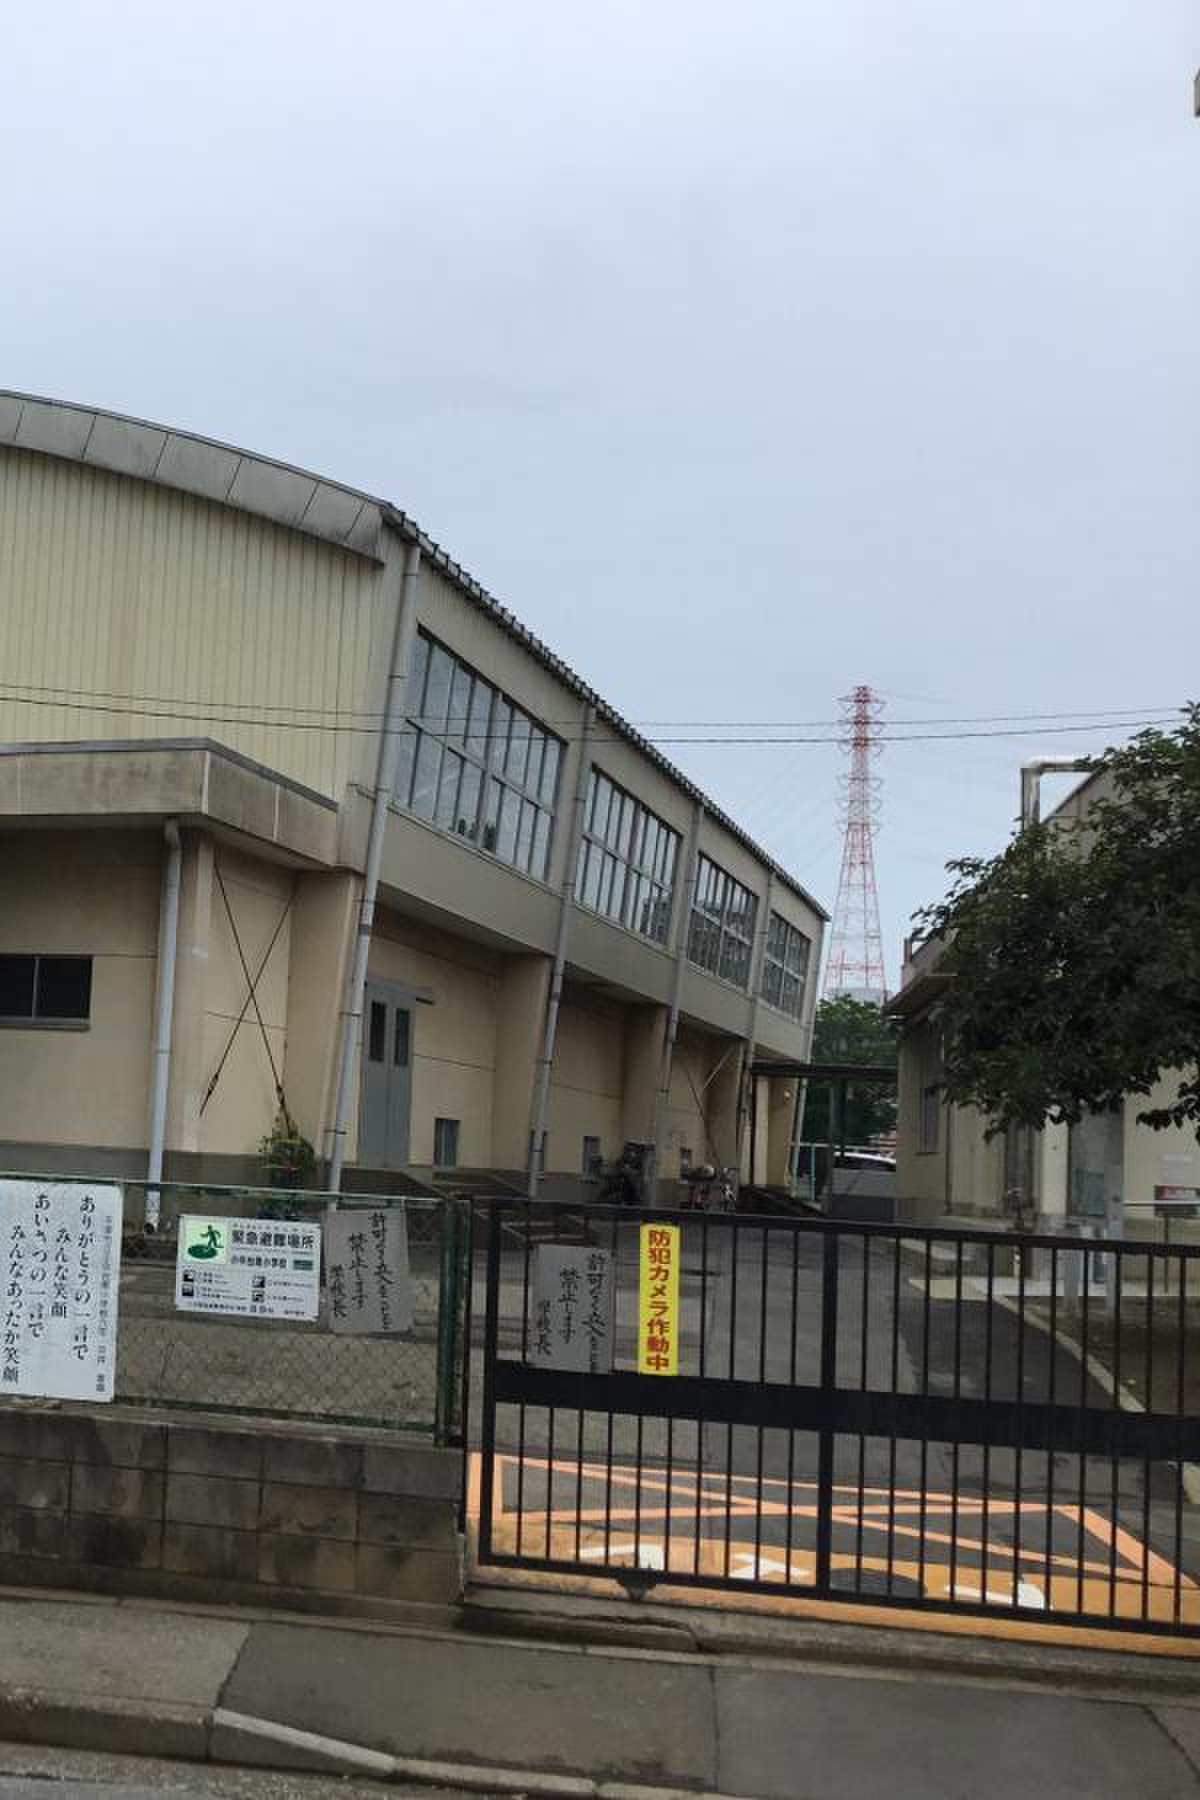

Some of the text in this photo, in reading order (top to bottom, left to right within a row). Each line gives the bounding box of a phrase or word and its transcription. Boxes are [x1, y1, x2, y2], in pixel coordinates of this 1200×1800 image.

[2, 1225, 27, 1385] みんなあったか笑顔
[28, 1194, 51, 1339] あいさつの一言で
[50, 1228, 73, 1320] みんな笑顔
[73, 1195, 96, 1361] ありがとうの一言で
[231, 1229, 315, 1249] 緊急避難場所
[646, 1229, 671, 1371] 防犯カメラ作動中
